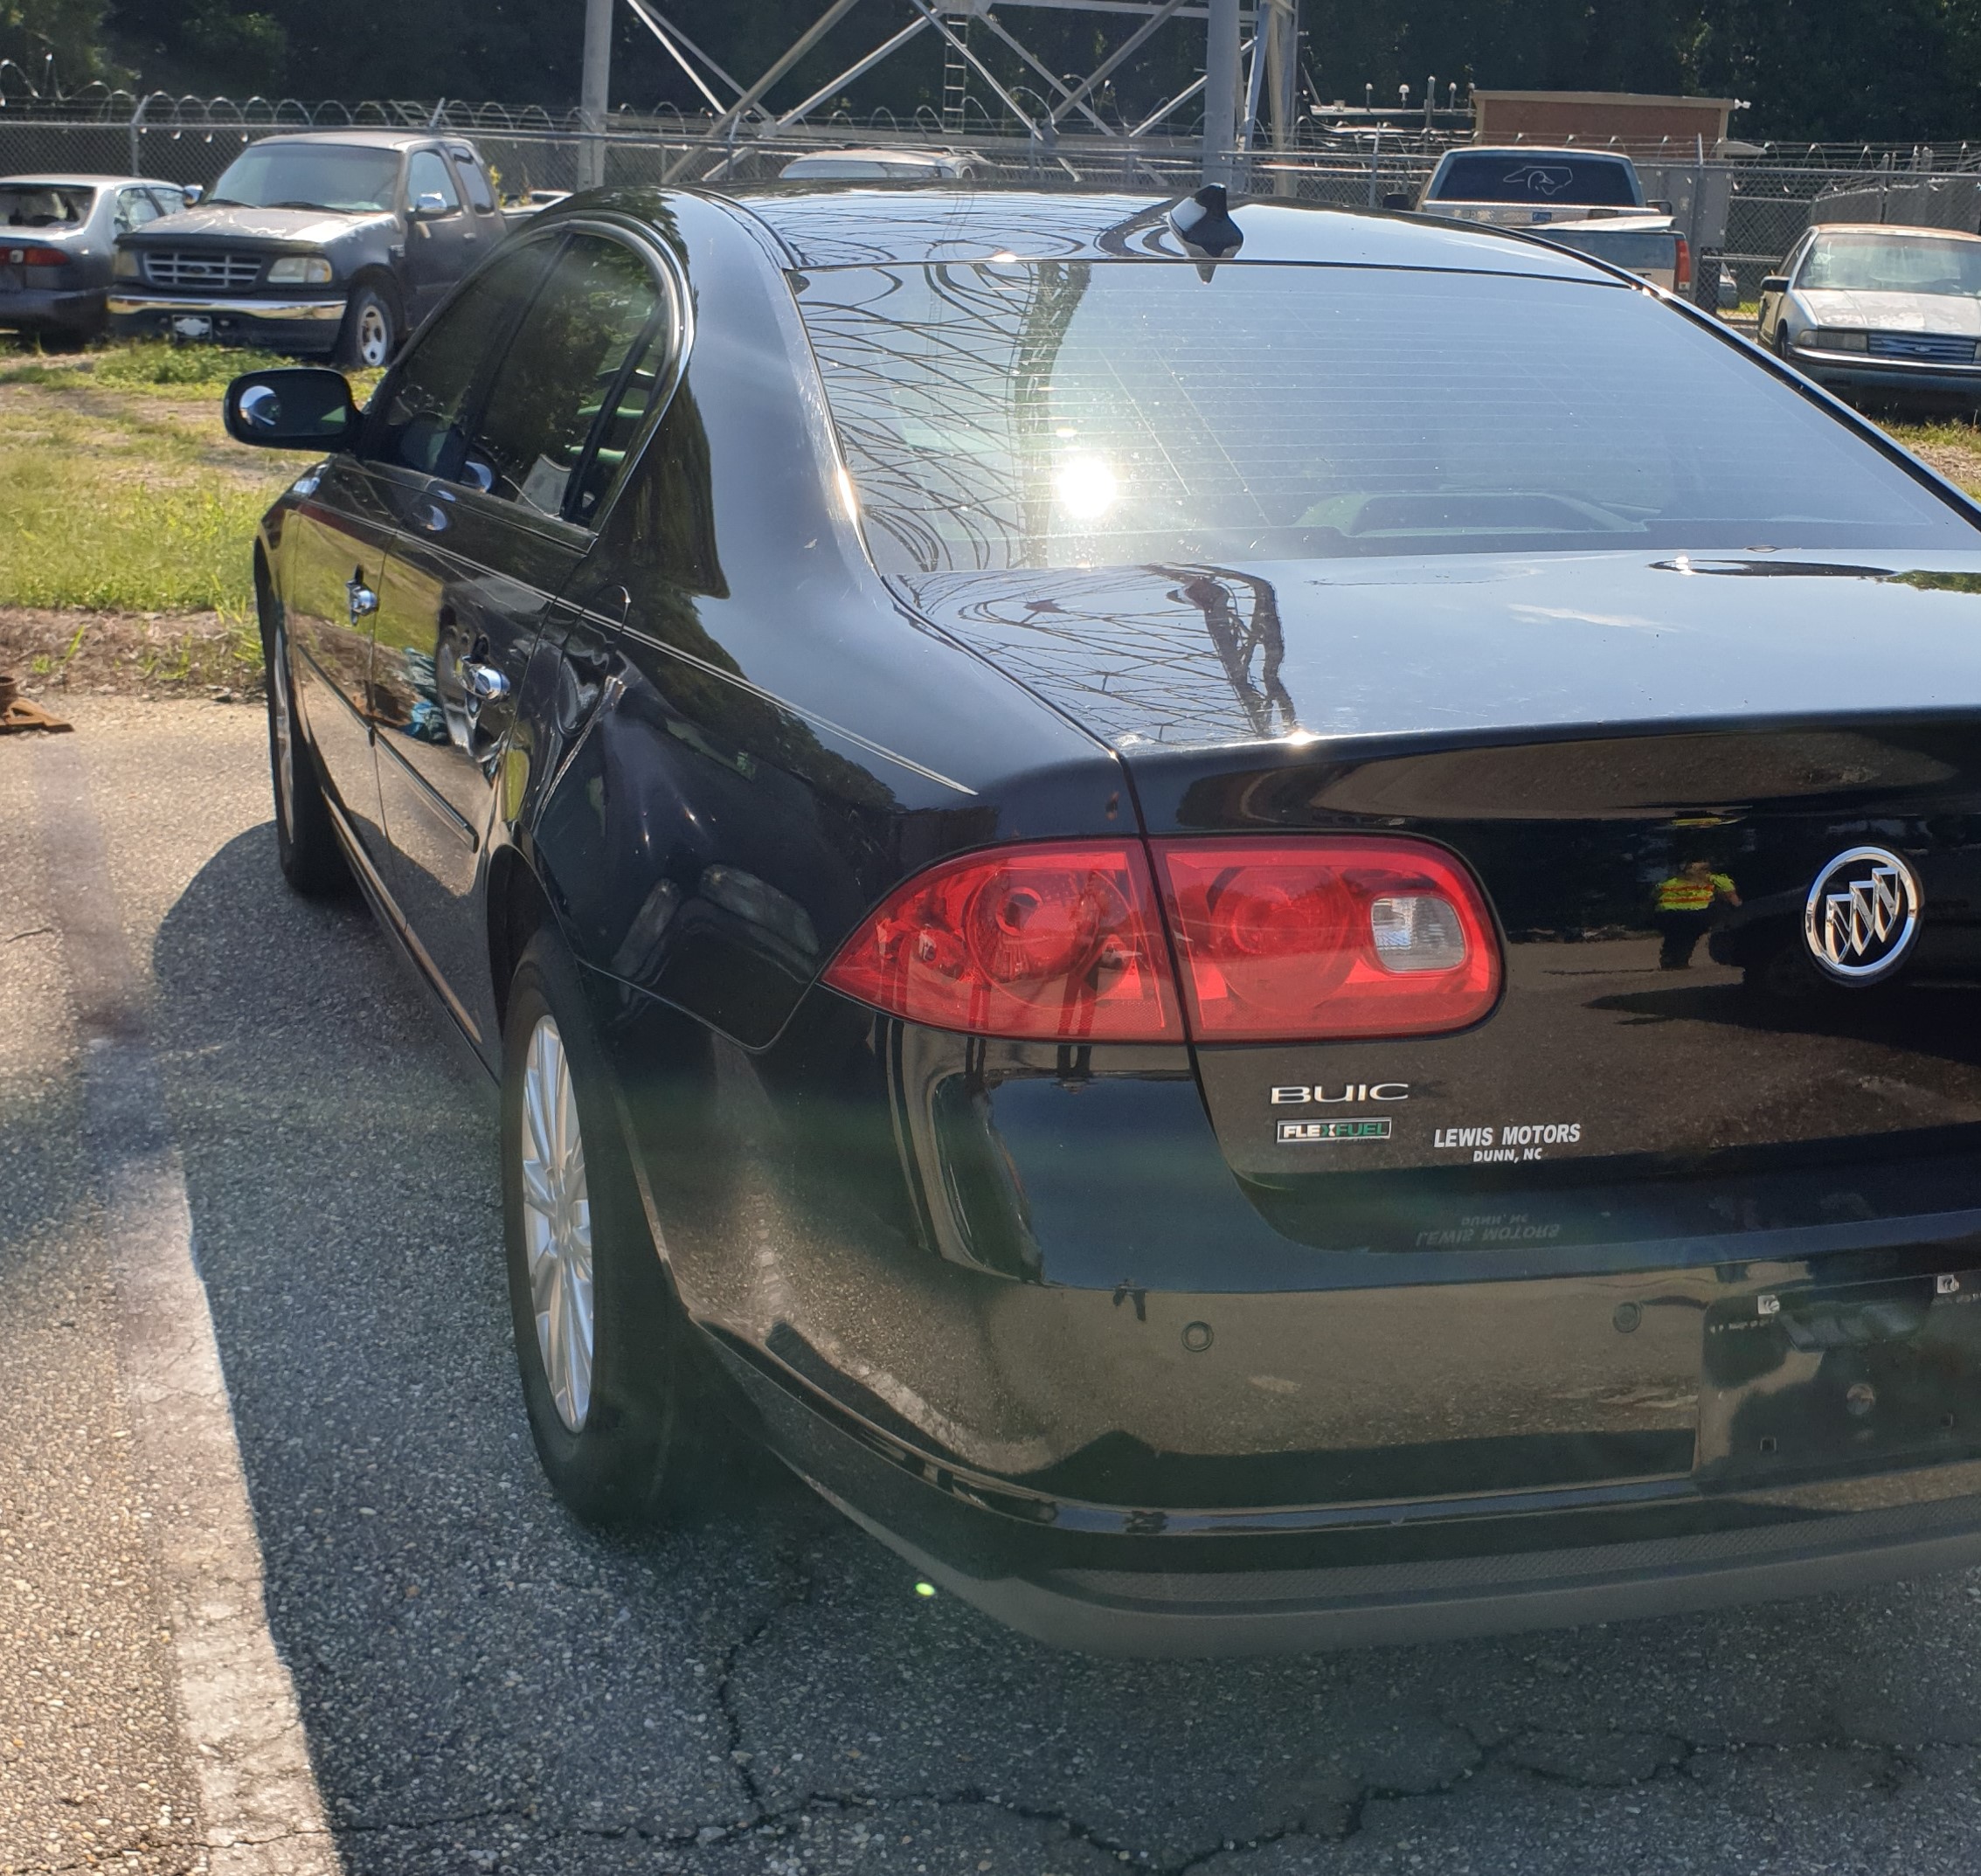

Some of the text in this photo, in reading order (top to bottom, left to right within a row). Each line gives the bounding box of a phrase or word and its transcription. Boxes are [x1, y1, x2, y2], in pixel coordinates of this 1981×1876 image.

[1433, 1123, 1581, 1148] LEWIS MOTORS
[1472, 1147, 1542, 1164] DUNN, NC
